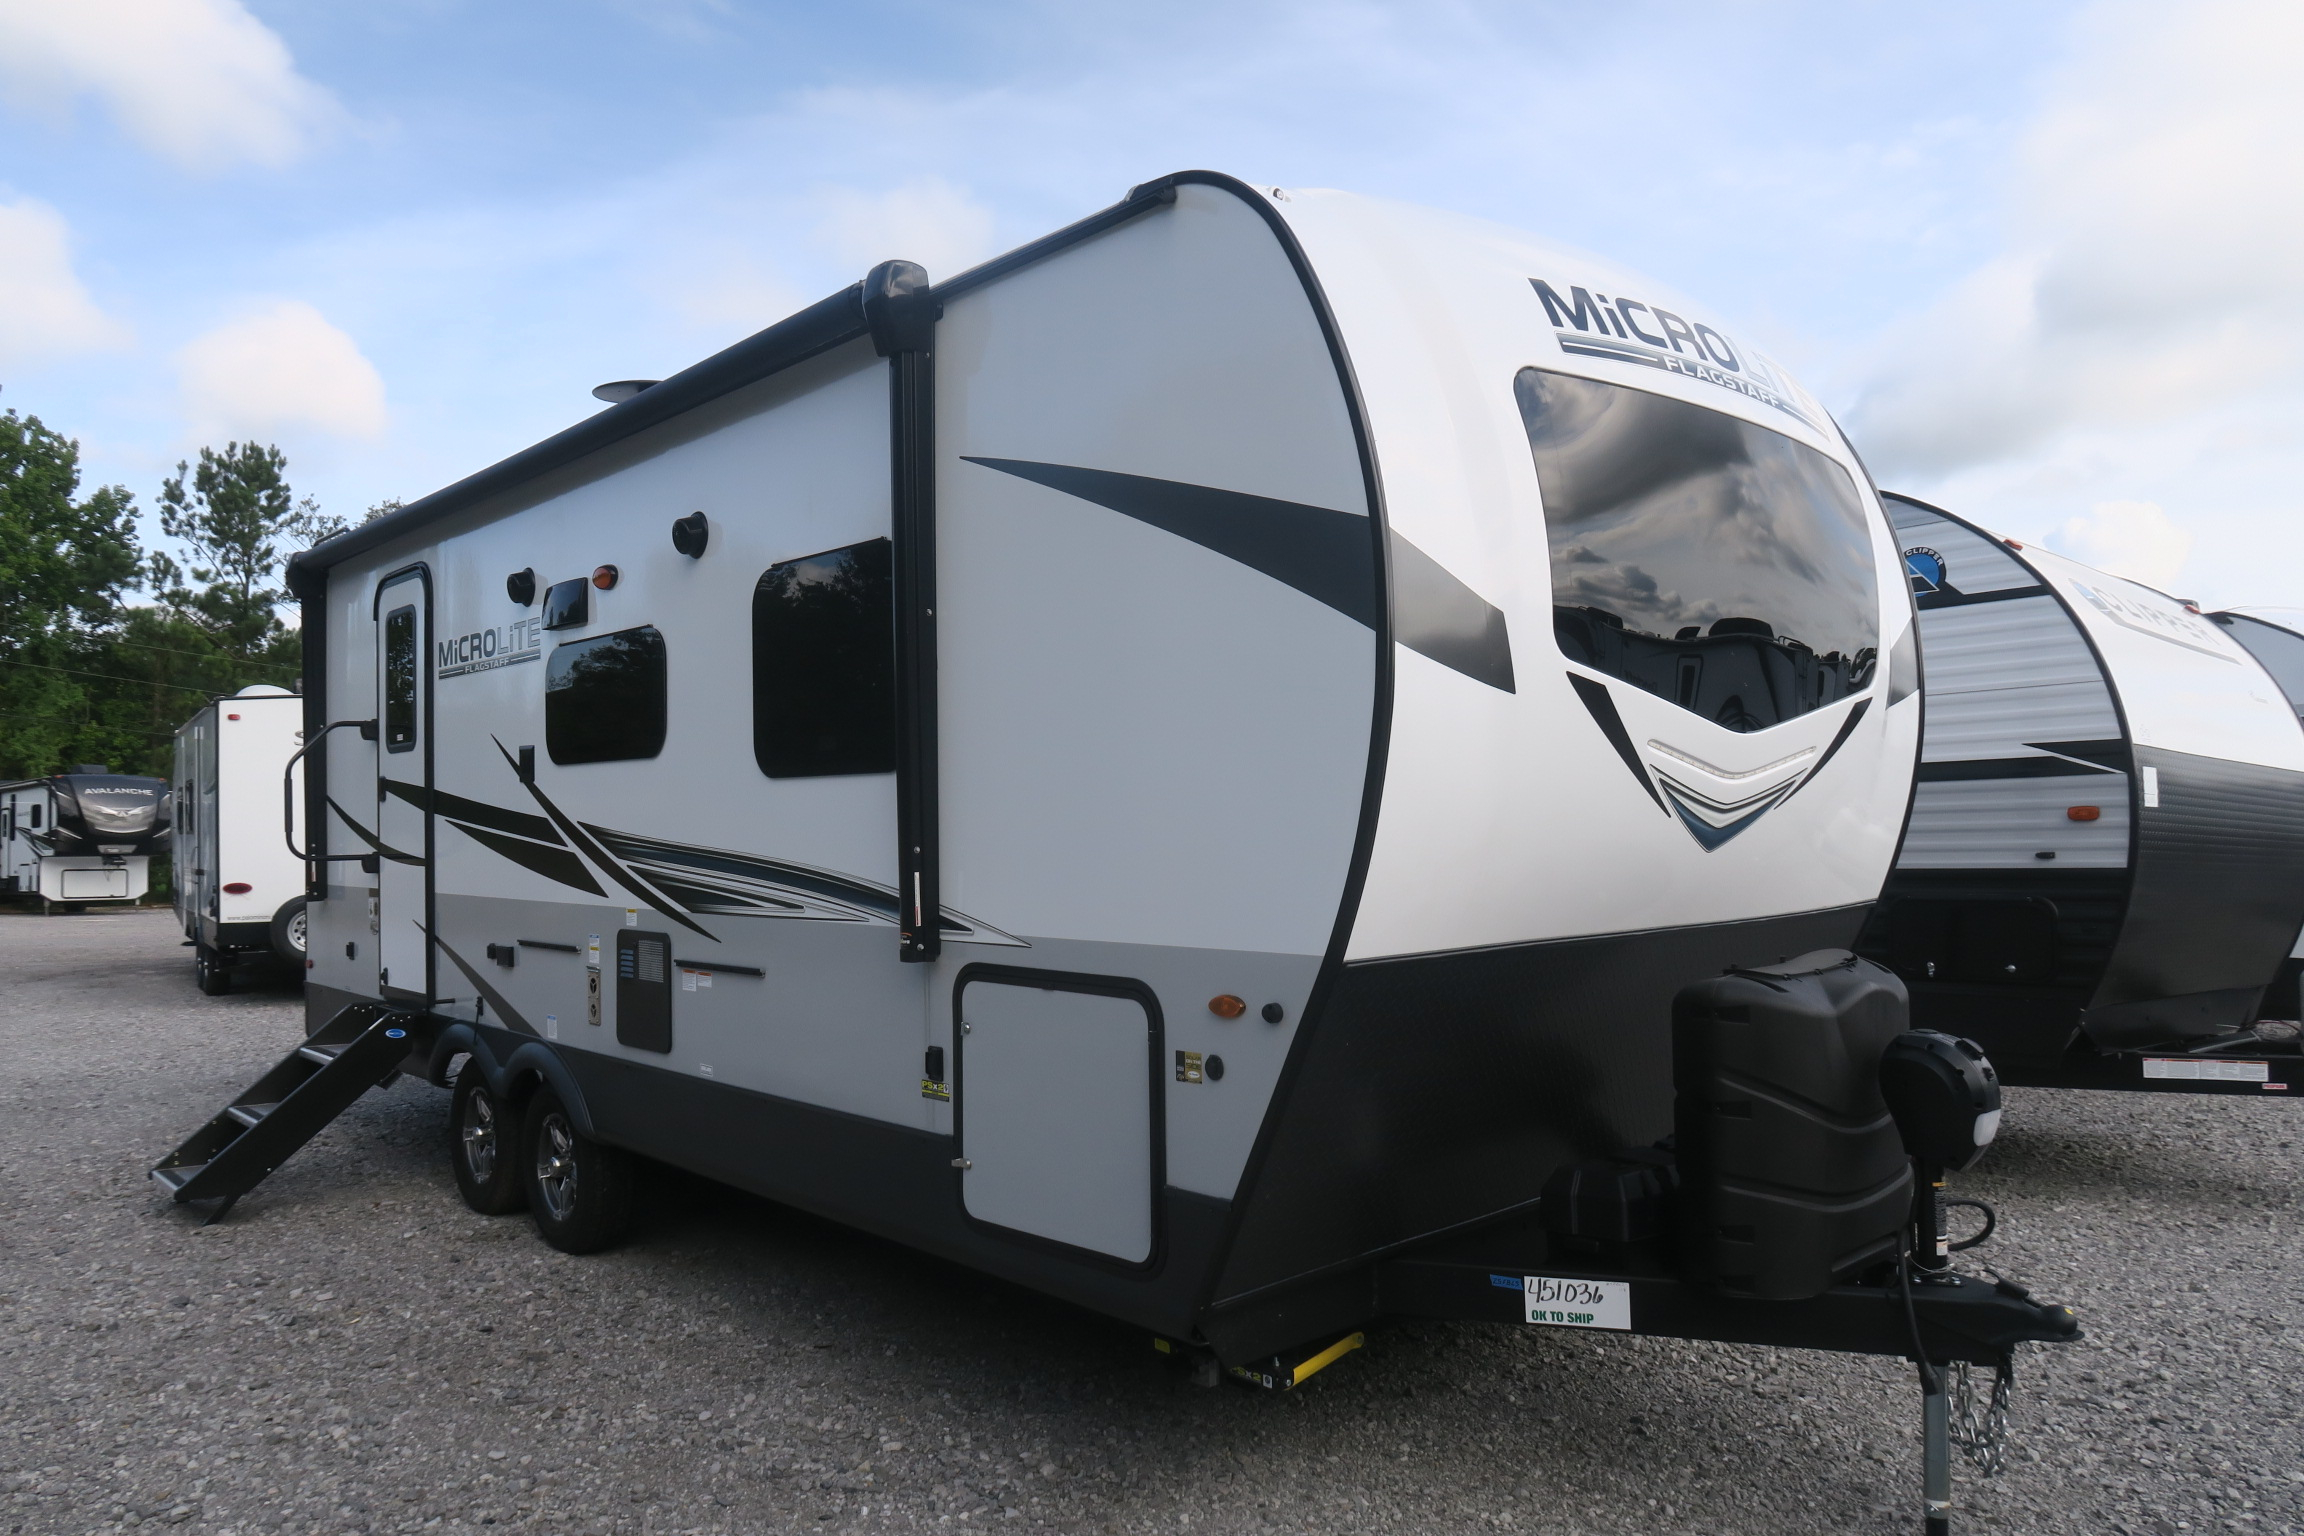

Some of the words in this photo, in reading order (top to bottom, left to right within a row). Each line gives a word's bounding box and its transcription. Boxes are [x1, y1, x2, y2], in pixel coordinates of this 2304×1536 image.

[1662, 355, 1779, 408] FLAGSTAFF
[1905, 547, 1944, 566] CLIPPER
[2091, 586, 2221, 647] CLIPPER
[464, 657, 510, 674] FLAGSTAFF
[84, 787, 154, 796] AVALANCHE
[1527, 1278, 1604, 1305] 451036
[1531, 1309, 1547, 1321] OK
[1549, 1310, 1564, 1323] TO
[1567, 1312, 1594, 1325] SHIP
